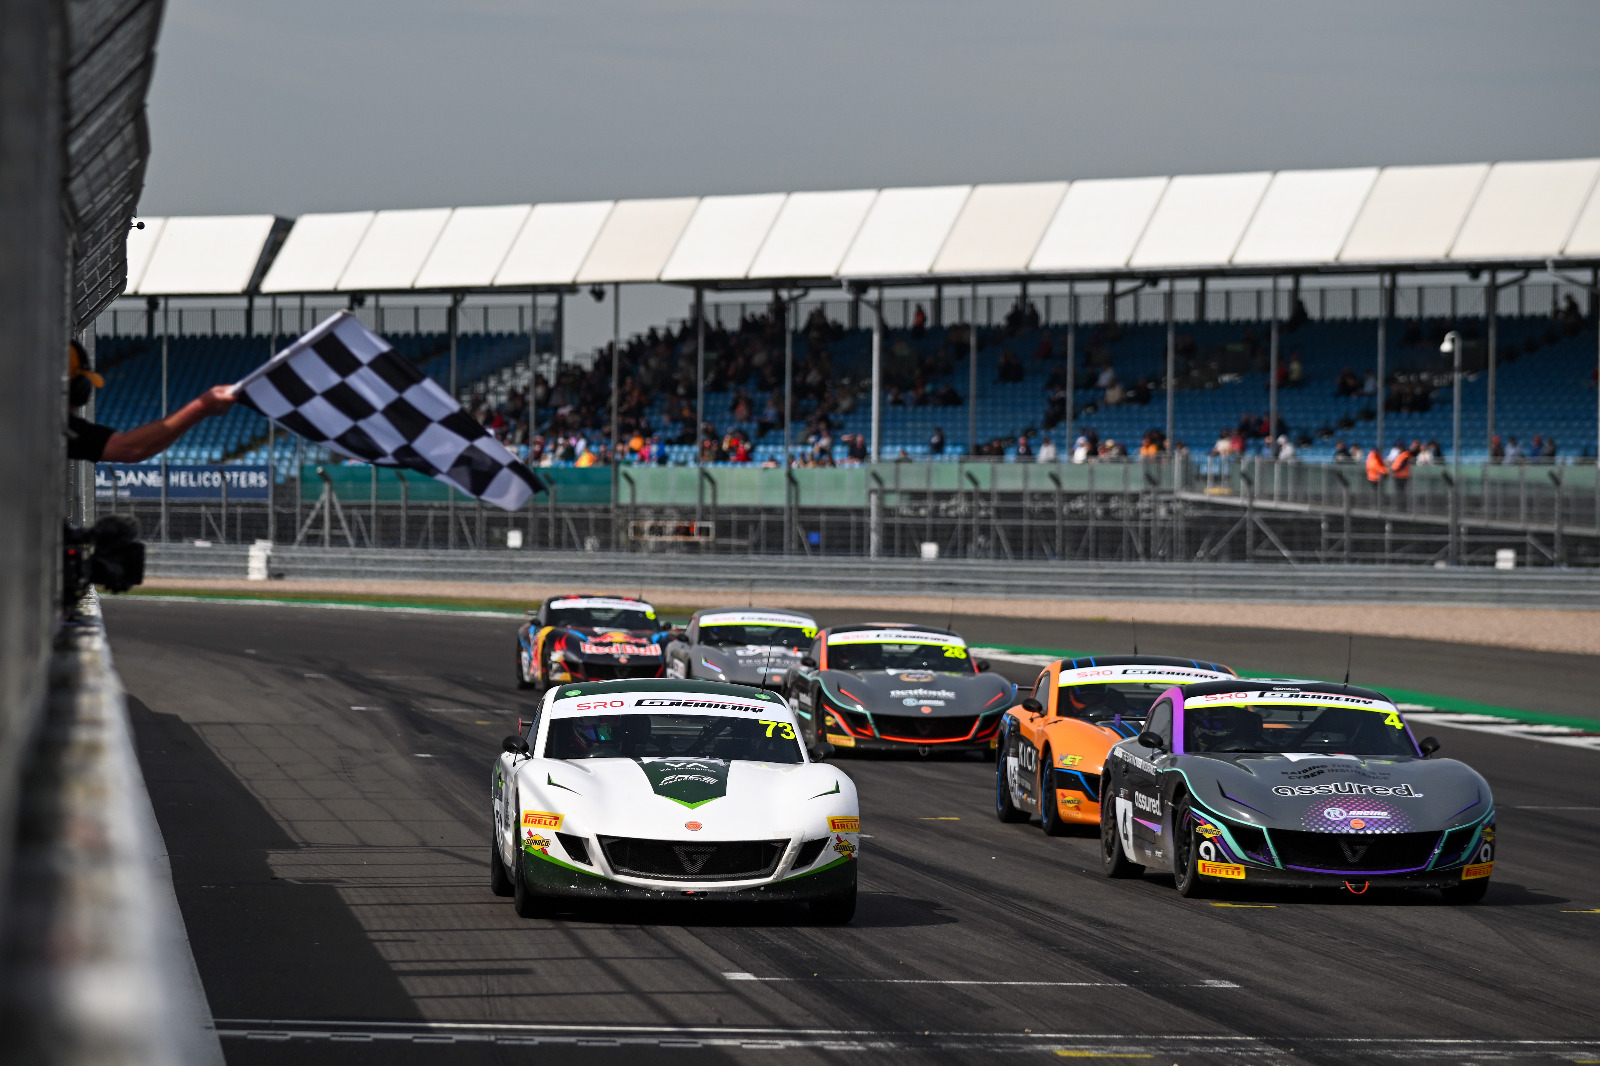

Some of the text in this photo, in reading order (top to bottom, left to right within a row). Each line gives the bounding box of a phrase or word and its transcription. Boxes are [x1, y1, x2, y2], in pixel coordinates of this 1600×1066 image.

[580, 642, 621, 654] Red
[622, 643, 661, 656] Bull
[1076, 669, 1113, 678] SRO
[1205, 692, 1248, 702] SRO
[576, 700, 625, 711] SRO
[1384, 713, 1404, 730] 4
[758, 719, 796, 740] 73
[1287, 769, 1325, 780] CYBER
[1272, 782, 1424, 798] assured.
[1134, 790, 1162, 817] assured.
[523, 813, 560, 827] PIRELLI
[1123, 808, 1130, 849] 4
[1197, 826, 1222, 836] SUNOCO
[525, 838, 551, 848] SUNOCO
[1201, 862, 1241, 877] PIRELLI
